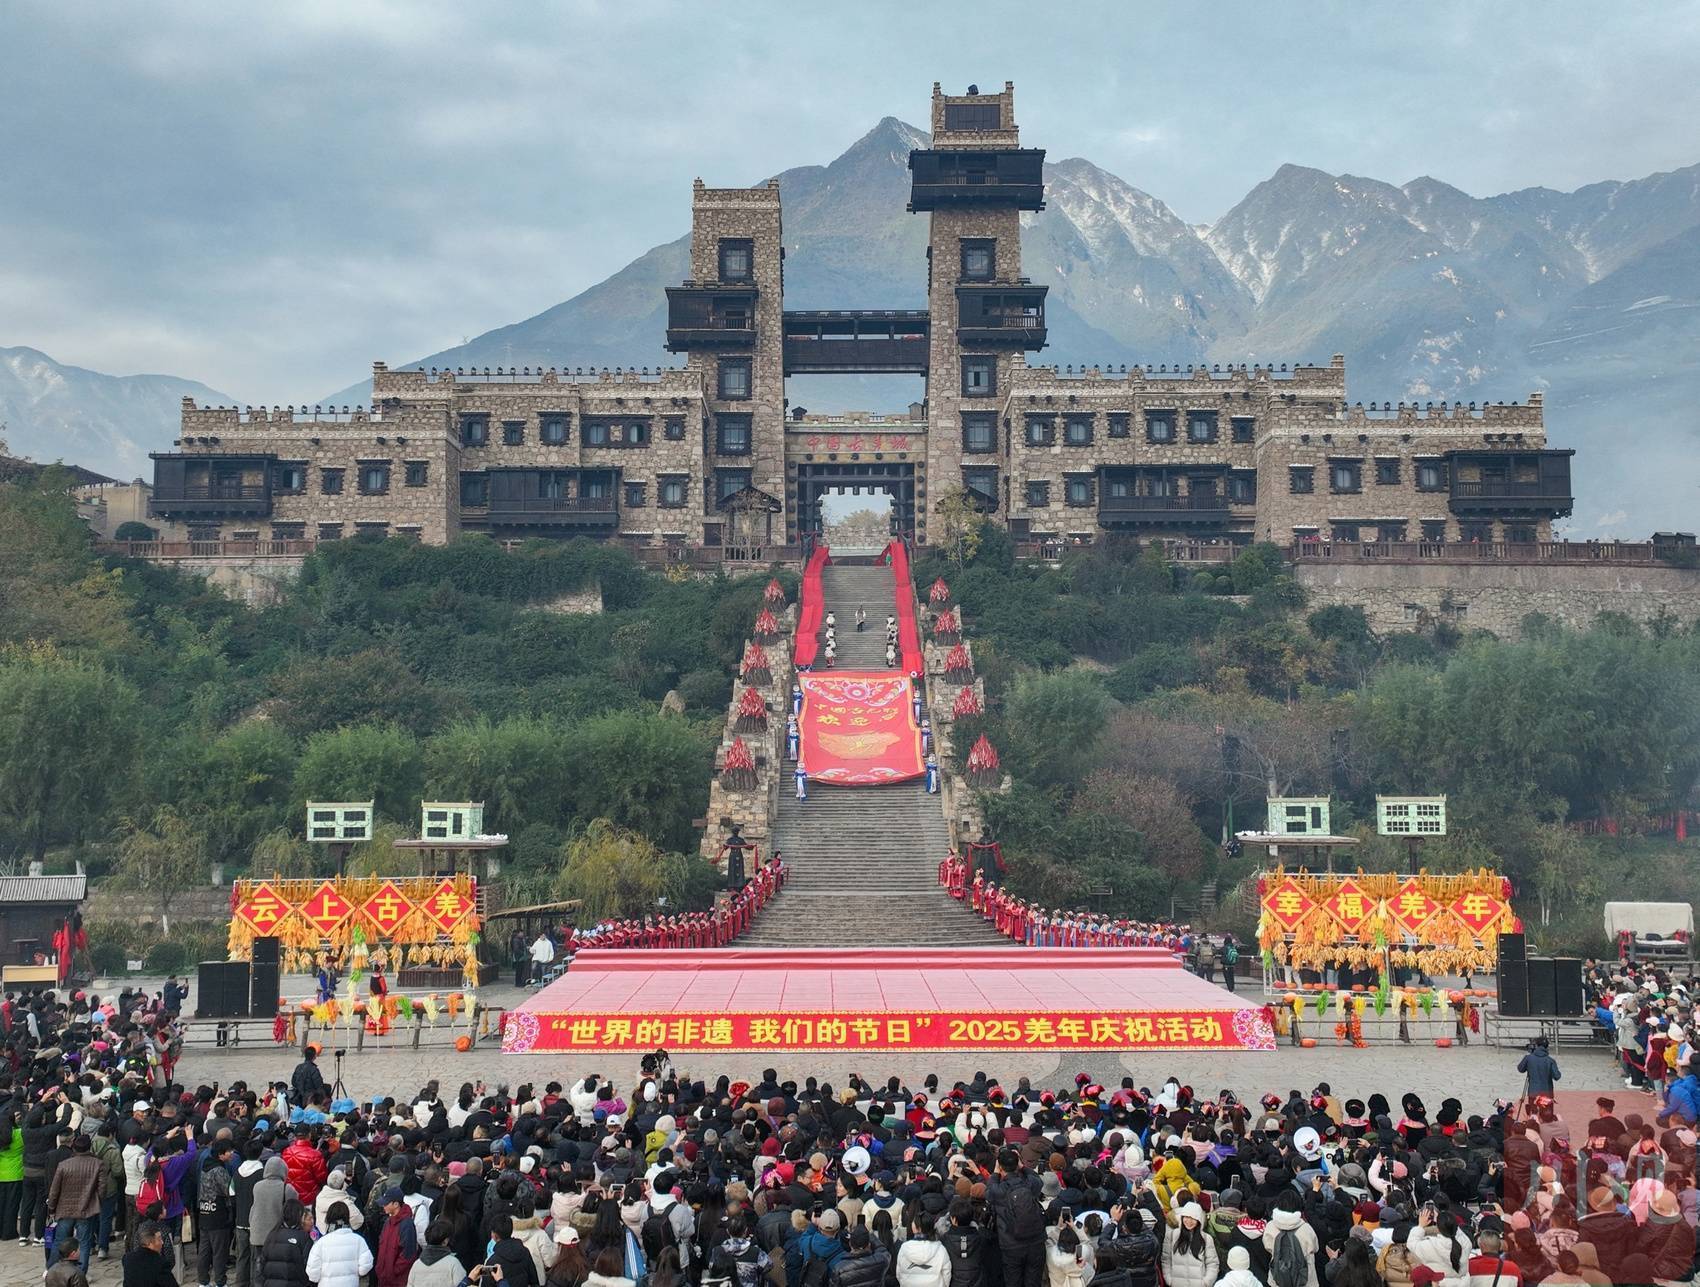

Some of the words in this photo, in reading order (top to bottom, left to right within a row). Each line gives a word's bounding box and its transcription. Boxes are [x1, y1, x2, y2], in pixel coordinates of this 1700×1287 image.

[250, 892, 462, 924] 云上古羌
[1275, 889, 1492, 922] 幸福羌年
[551, 1018, 734, 1046] “世界的非遗
[749, 1017, 931, 1045] 我们的节日”
[949, 1016, 1223, 1044] 2025羌年庆祝活动
